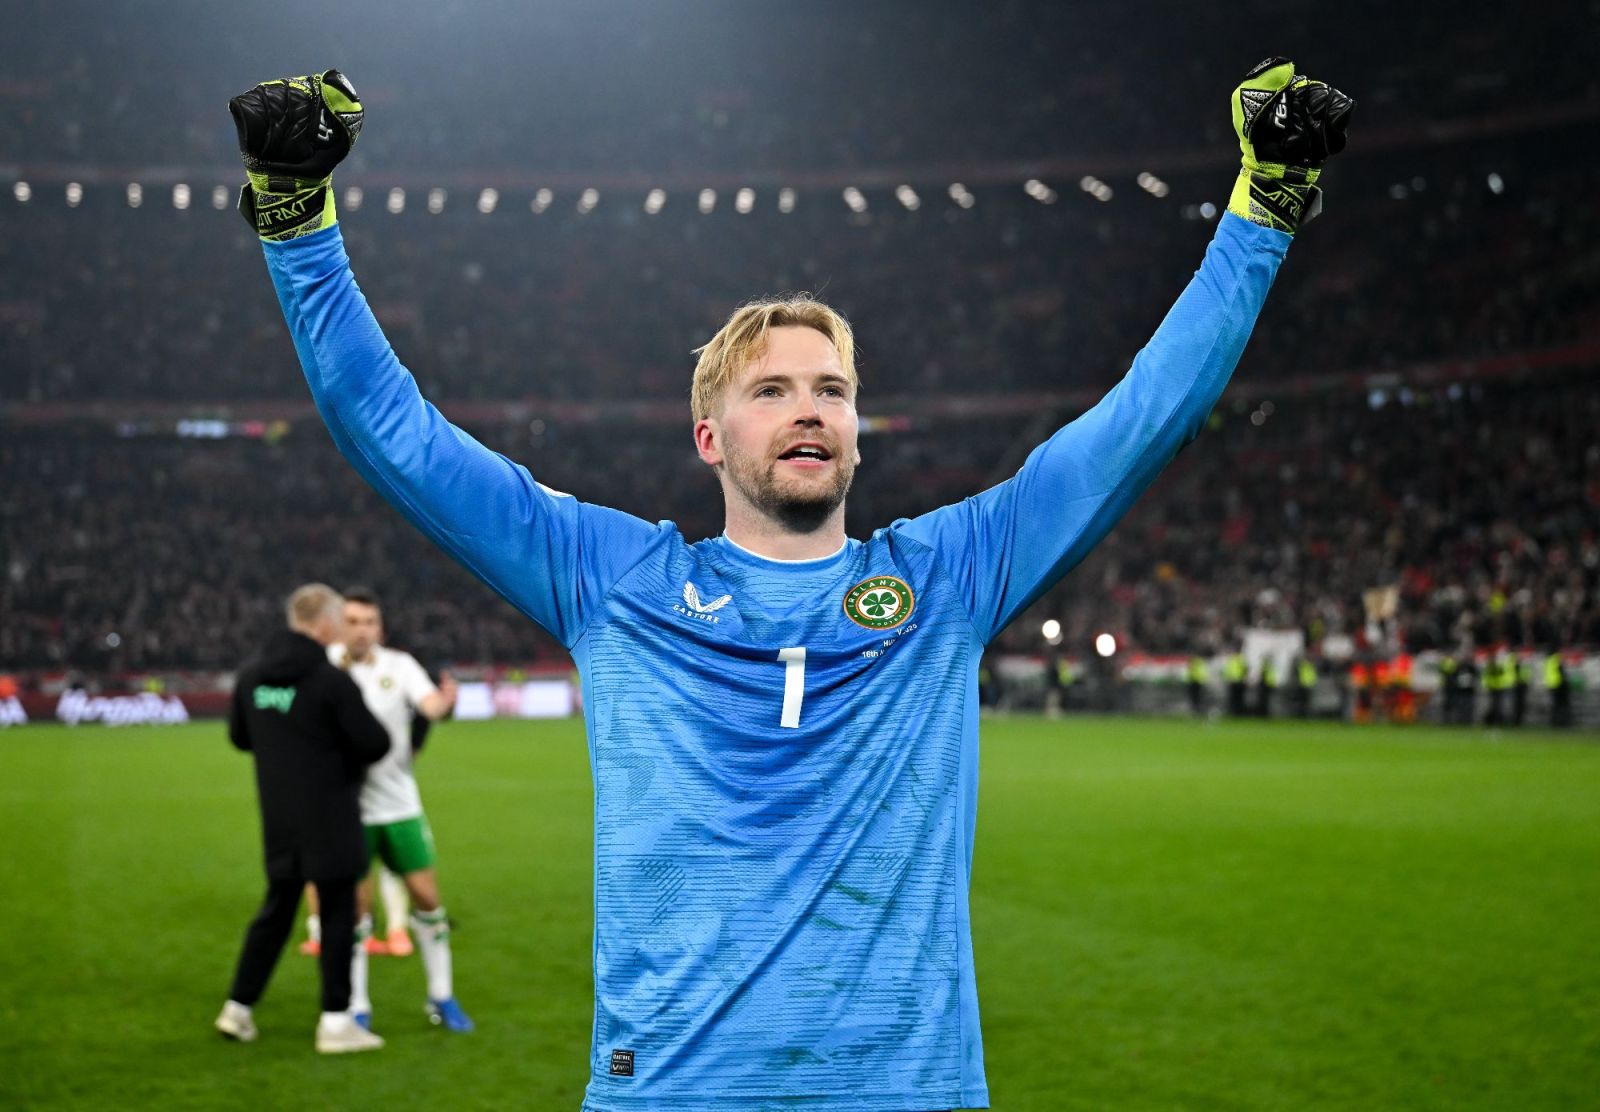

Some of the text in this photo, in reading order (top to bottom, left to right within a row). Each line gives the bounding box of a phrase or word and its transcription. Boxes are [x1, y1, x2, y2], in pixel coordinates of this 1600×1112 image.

[848, 580, 896, 608] IRELAND
[673, 604, 720, 624] CASTORE
[871, 607, 908, 627] FOOTBALL
[777, 647, 806, 729] 1
